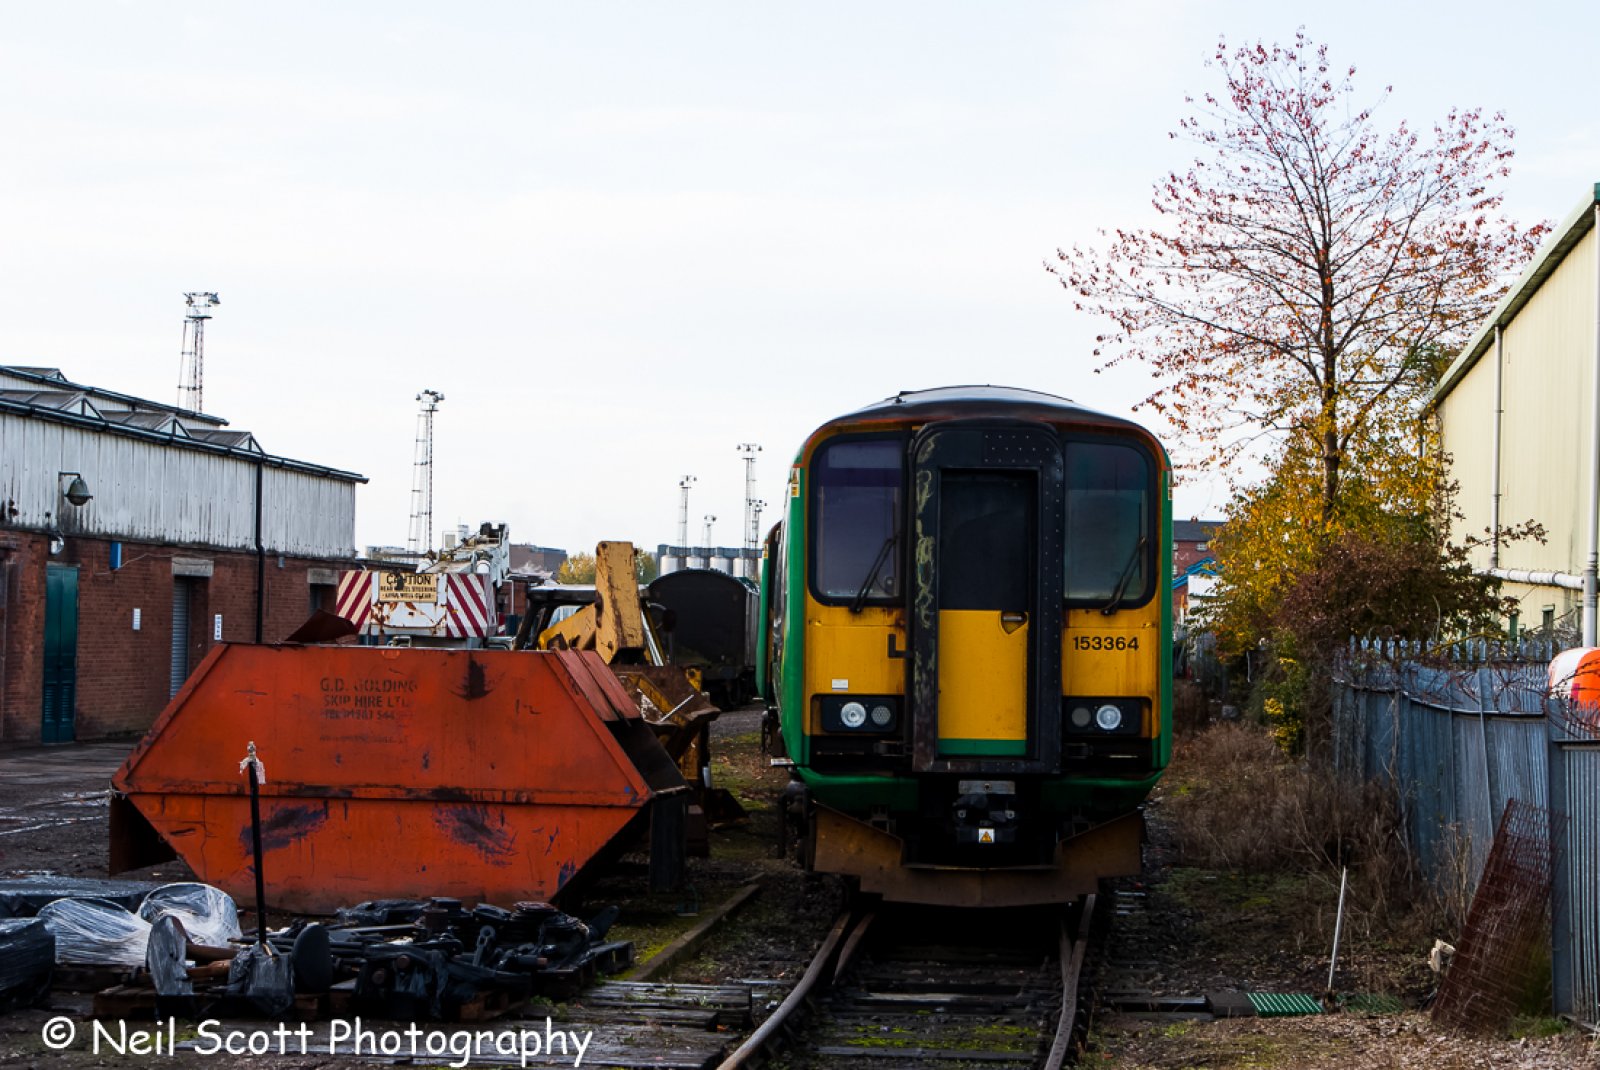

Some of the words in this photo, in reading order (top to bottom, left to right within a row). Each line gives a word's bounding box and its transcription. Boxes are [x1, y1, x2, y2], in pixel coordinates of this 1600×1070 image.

[386, 573, 431, 585] CTION
[1073, 636, 1139, 651] 153364
[323, 694, 351, 707] SKIP
[354, 695, 383, 708] HIRE
